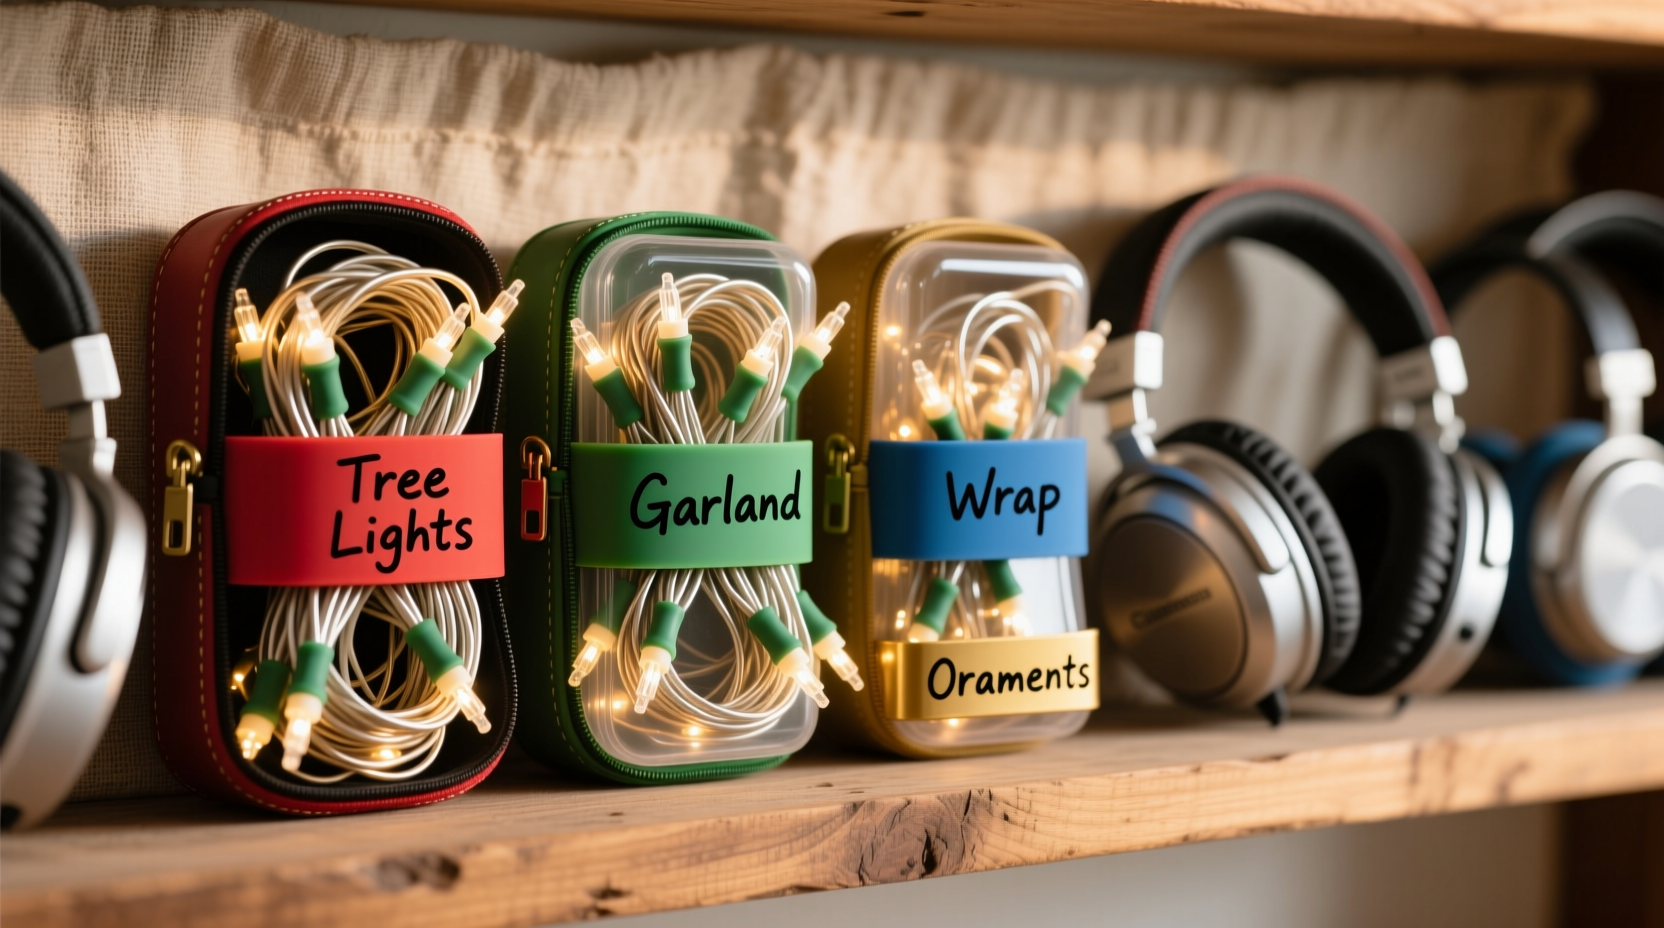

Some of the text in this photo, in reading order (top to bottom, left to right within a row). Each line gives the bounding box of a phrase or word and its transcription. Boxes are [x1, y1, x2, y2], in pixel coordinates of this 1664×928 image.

[336, 453, 450, 503] Tree
[629, 469, 802, 535] Garland
[945, 466, 1062, 536] Wrap
[330, 508, 474, 574] Lights
[927, 655, 1090, 701] Oraments
